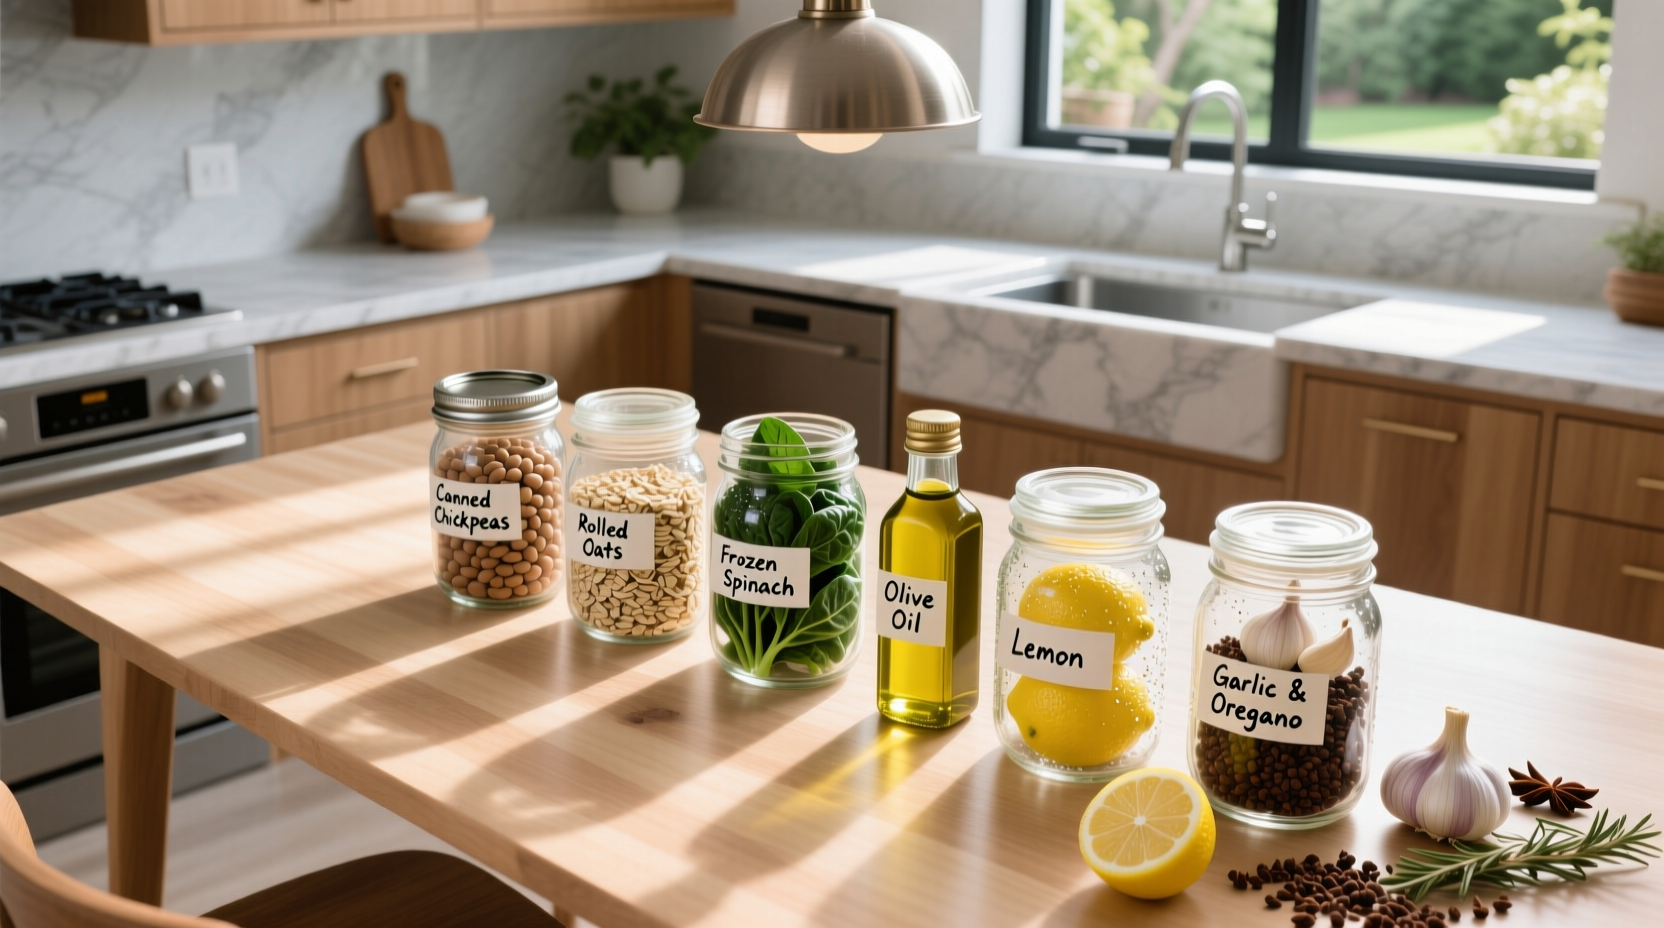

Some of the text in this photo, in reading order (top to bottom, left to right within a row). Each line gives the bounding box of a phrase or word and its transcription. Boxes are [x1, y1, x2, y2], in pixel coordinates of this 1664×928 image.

[436, 483, 491, 508] Canned
[434, 505, 510, 536] Chickpeas
[578, 512, 629, 540] Rolled
[582, 538, 623, 560] Oats
[720, 543, 777, 572] Frozen
[723, 568, 795, 598] Spinach
[884, 580, 935, 610] Olive
[891, 608, 921, 634] Oil
[1011, 627, 1083, 669] Lemon
[1213, 663, 1307, 703] Garlic &
[1211, 691, 1303, 733] Oregano
